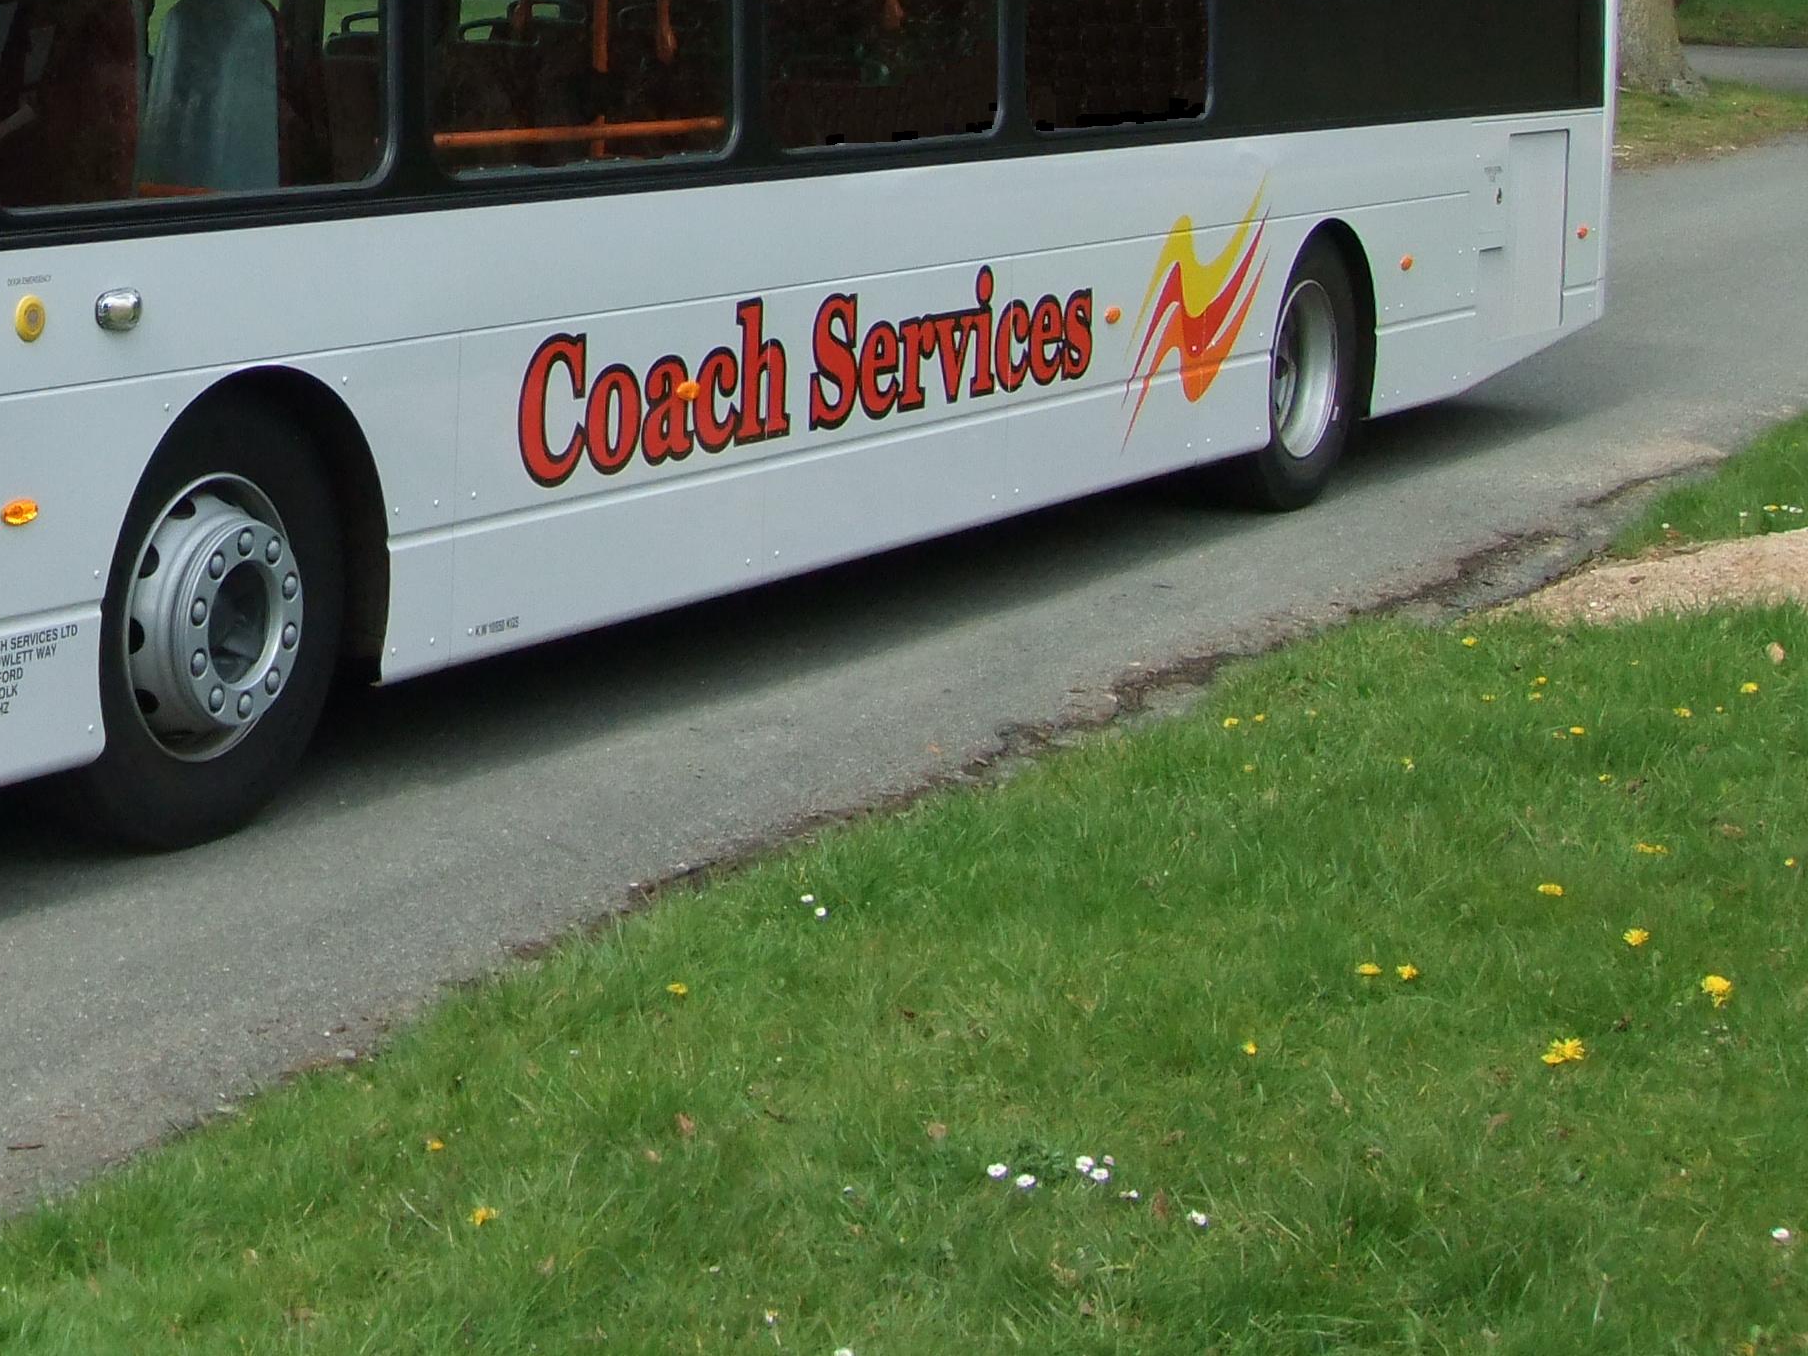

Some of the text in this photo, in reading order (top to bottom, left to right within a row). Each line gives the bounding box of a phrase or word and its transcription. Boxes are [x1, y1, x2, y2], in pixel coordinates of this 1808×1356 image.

[518, 264, 1094, 489] Coach Services
[10, 628, 58, 651] SERVICES
[60, 624, 78, 639] LTD
[36, 643, 58, 661] WAY
